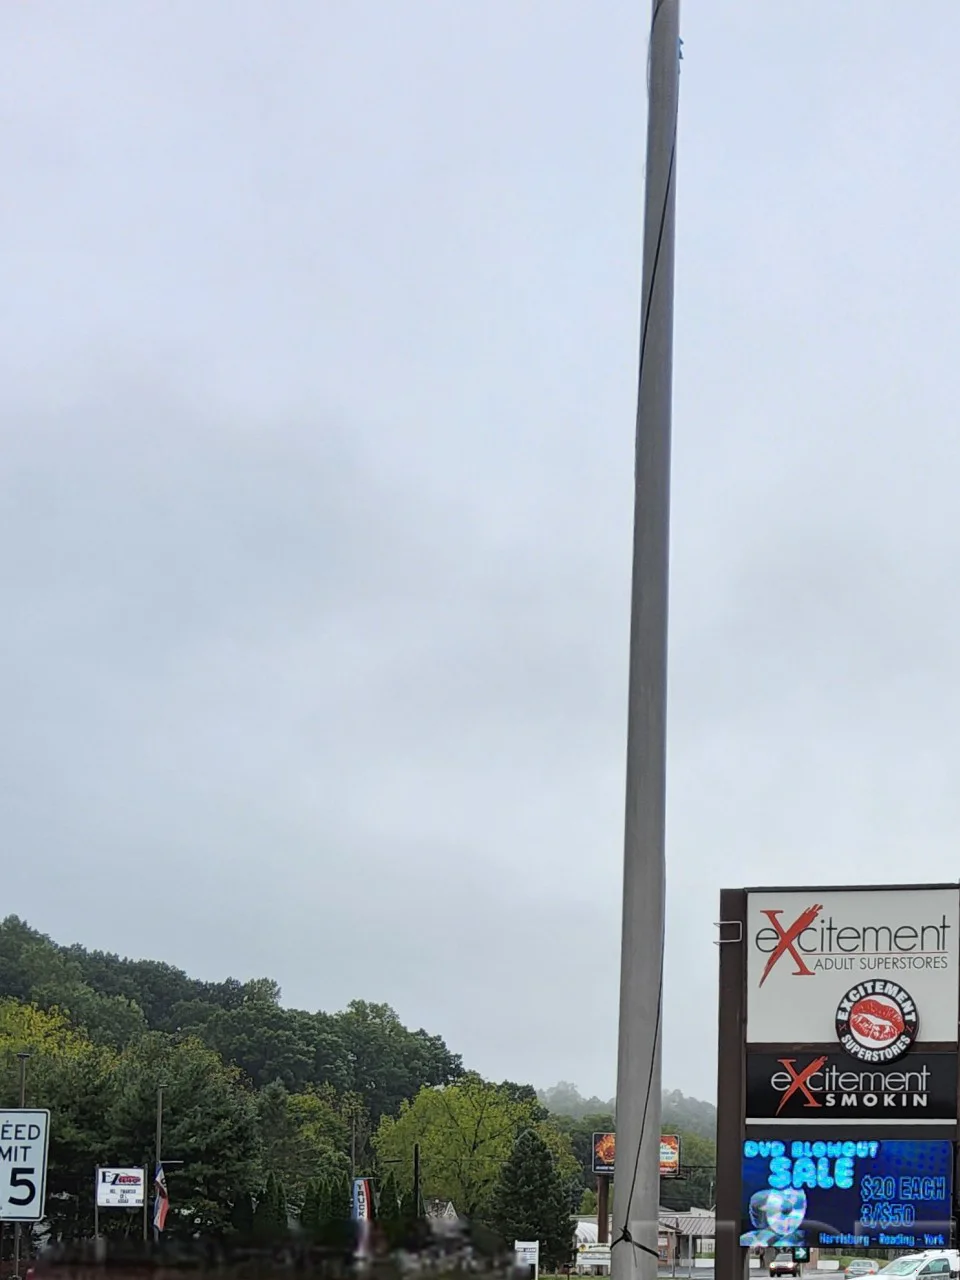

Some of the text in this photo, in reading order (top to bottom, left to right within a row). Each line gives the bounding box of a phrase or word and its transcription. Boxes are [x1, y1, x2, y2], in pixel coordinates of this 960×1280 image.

[814, 956, 948, 970] ADULT SUPERSTORES
[838, 981, 916, 1022] EXCITEMENT
[841, 1034, 911, 1062] SUPERSTORES
[825, 1093, 928, 1107] SMOKIN
[0, 1124, 40, 1140] EED
[0, 1146, 31, 1162] MIT
[744, 1141, 879, 1158] DVD BLOWOUT
[768, 1156, 854, 1189] SALE
[8, 1168, 36, 1206] 5
[860, 1175, 945, 1201] $20 EACH
[860, 1202, 915, 1229] 3/$50
[819, 1233, 944, 1246] Harrisburg Reading York
